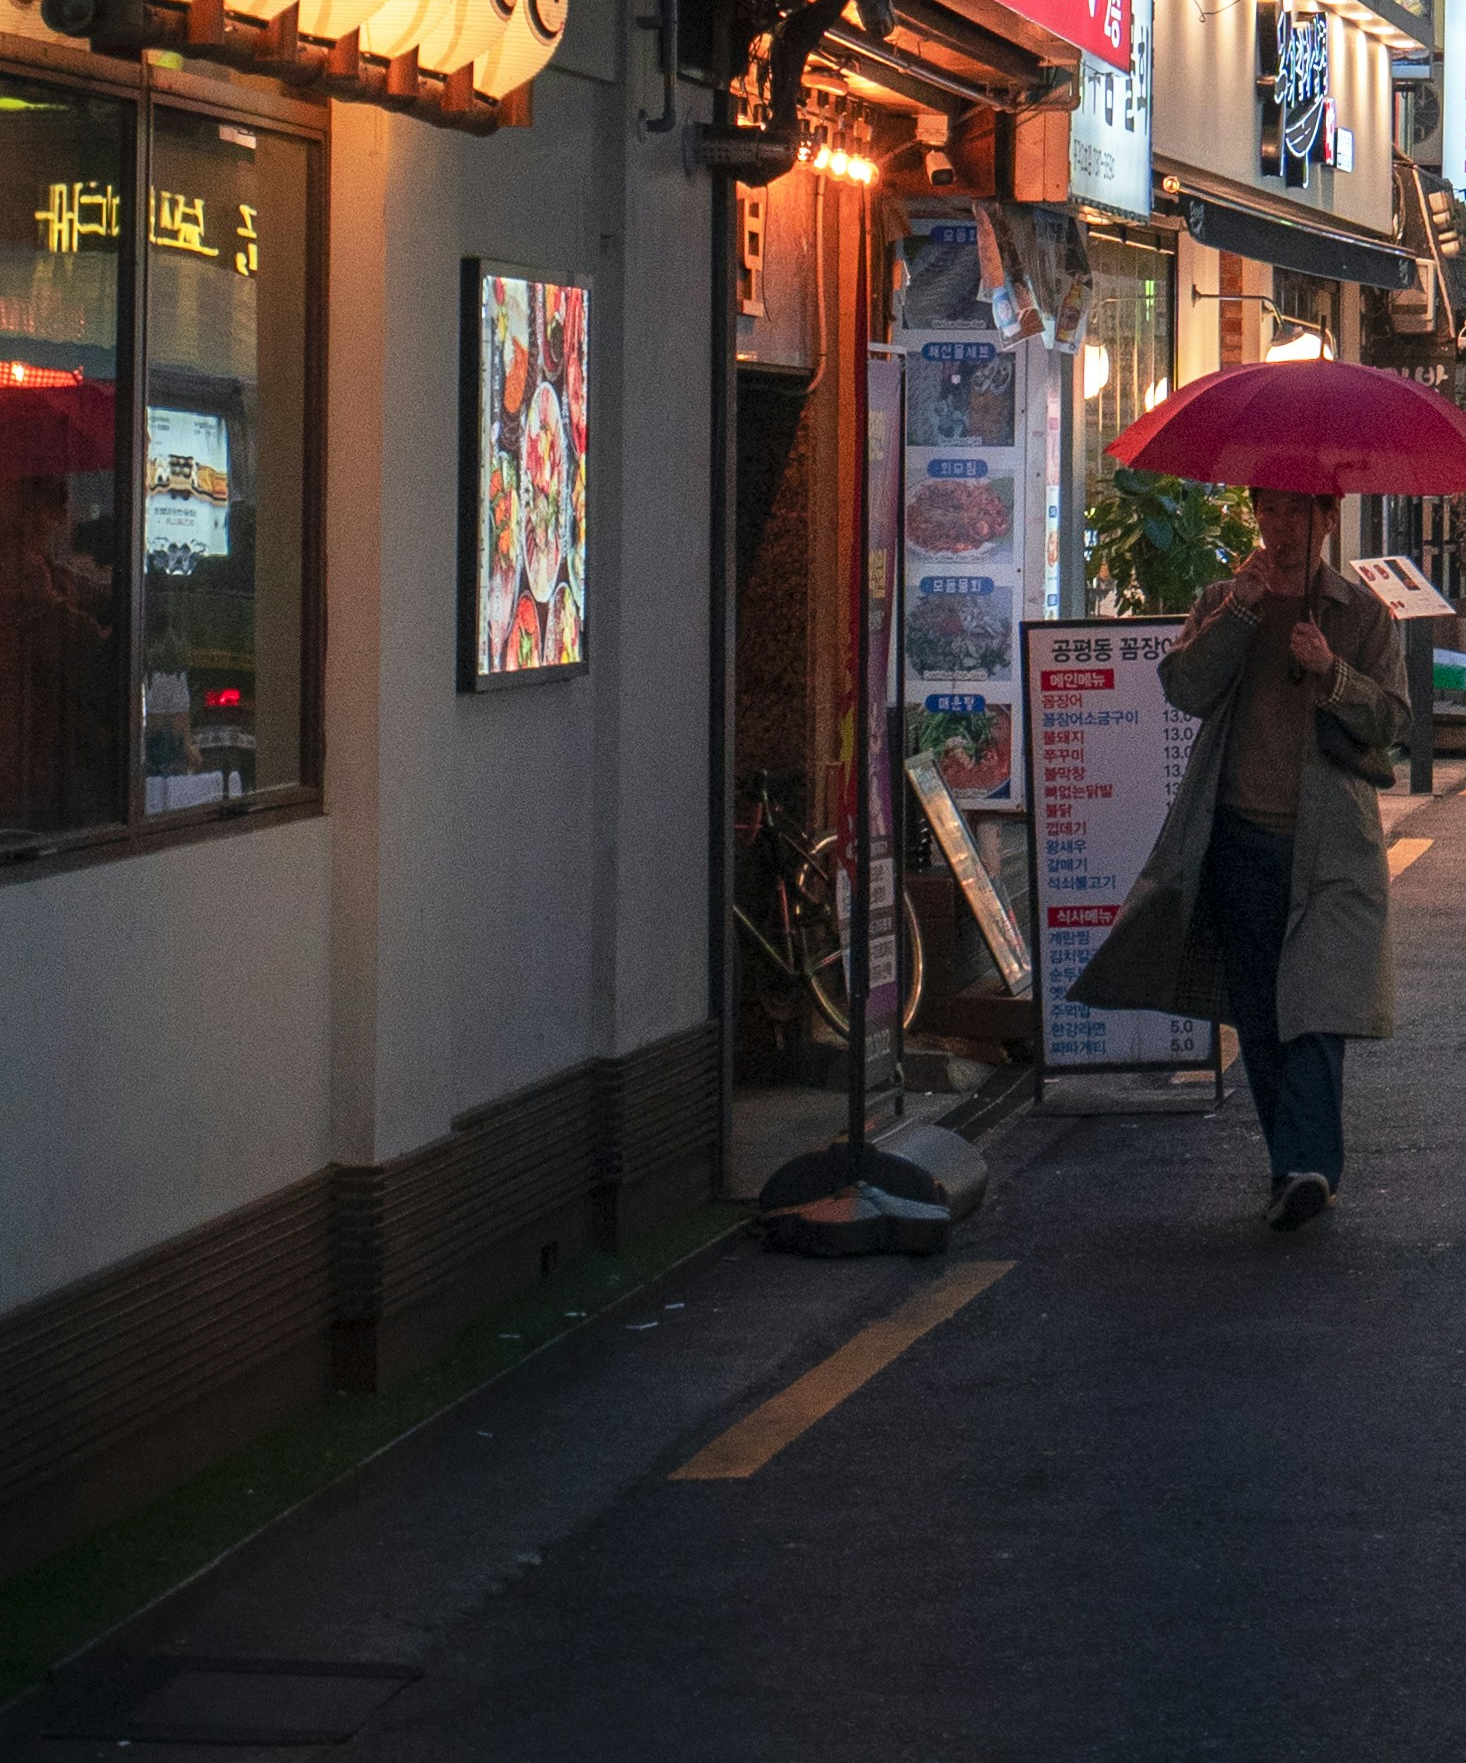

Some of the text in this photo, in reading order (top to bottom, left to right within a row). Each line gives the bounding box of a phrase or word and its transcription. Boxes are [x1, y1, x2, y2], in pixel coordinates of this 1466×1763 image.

[1051, 638, 1114, 663] 공평동
[1049, 671, 1106, 688] 메인메뉴
[1041, 694, 1083, 710] 꼼장어
[1042, 710, 1139, 727] 꼼장어소금구이
[1162, 727, 1194, 742] 13.0
[1044, 766, 1086, 782] 불막창
[1044, 784, 1114, 800] 뼈없는닭발
[1045, 821, 1088, 837] 껍데기
[1046, 839, 1088, 855] 왕새우
[1046, 858, 1088, 874] 갈매기
[1047, 875, 1117, 892] 석쇠불고기
[1056, 909, 1113, 925] 식사메뉴
[1170, 1019, 1194, 1034] 5.0
[1170, 1037, 1194, 1053] 5.0
